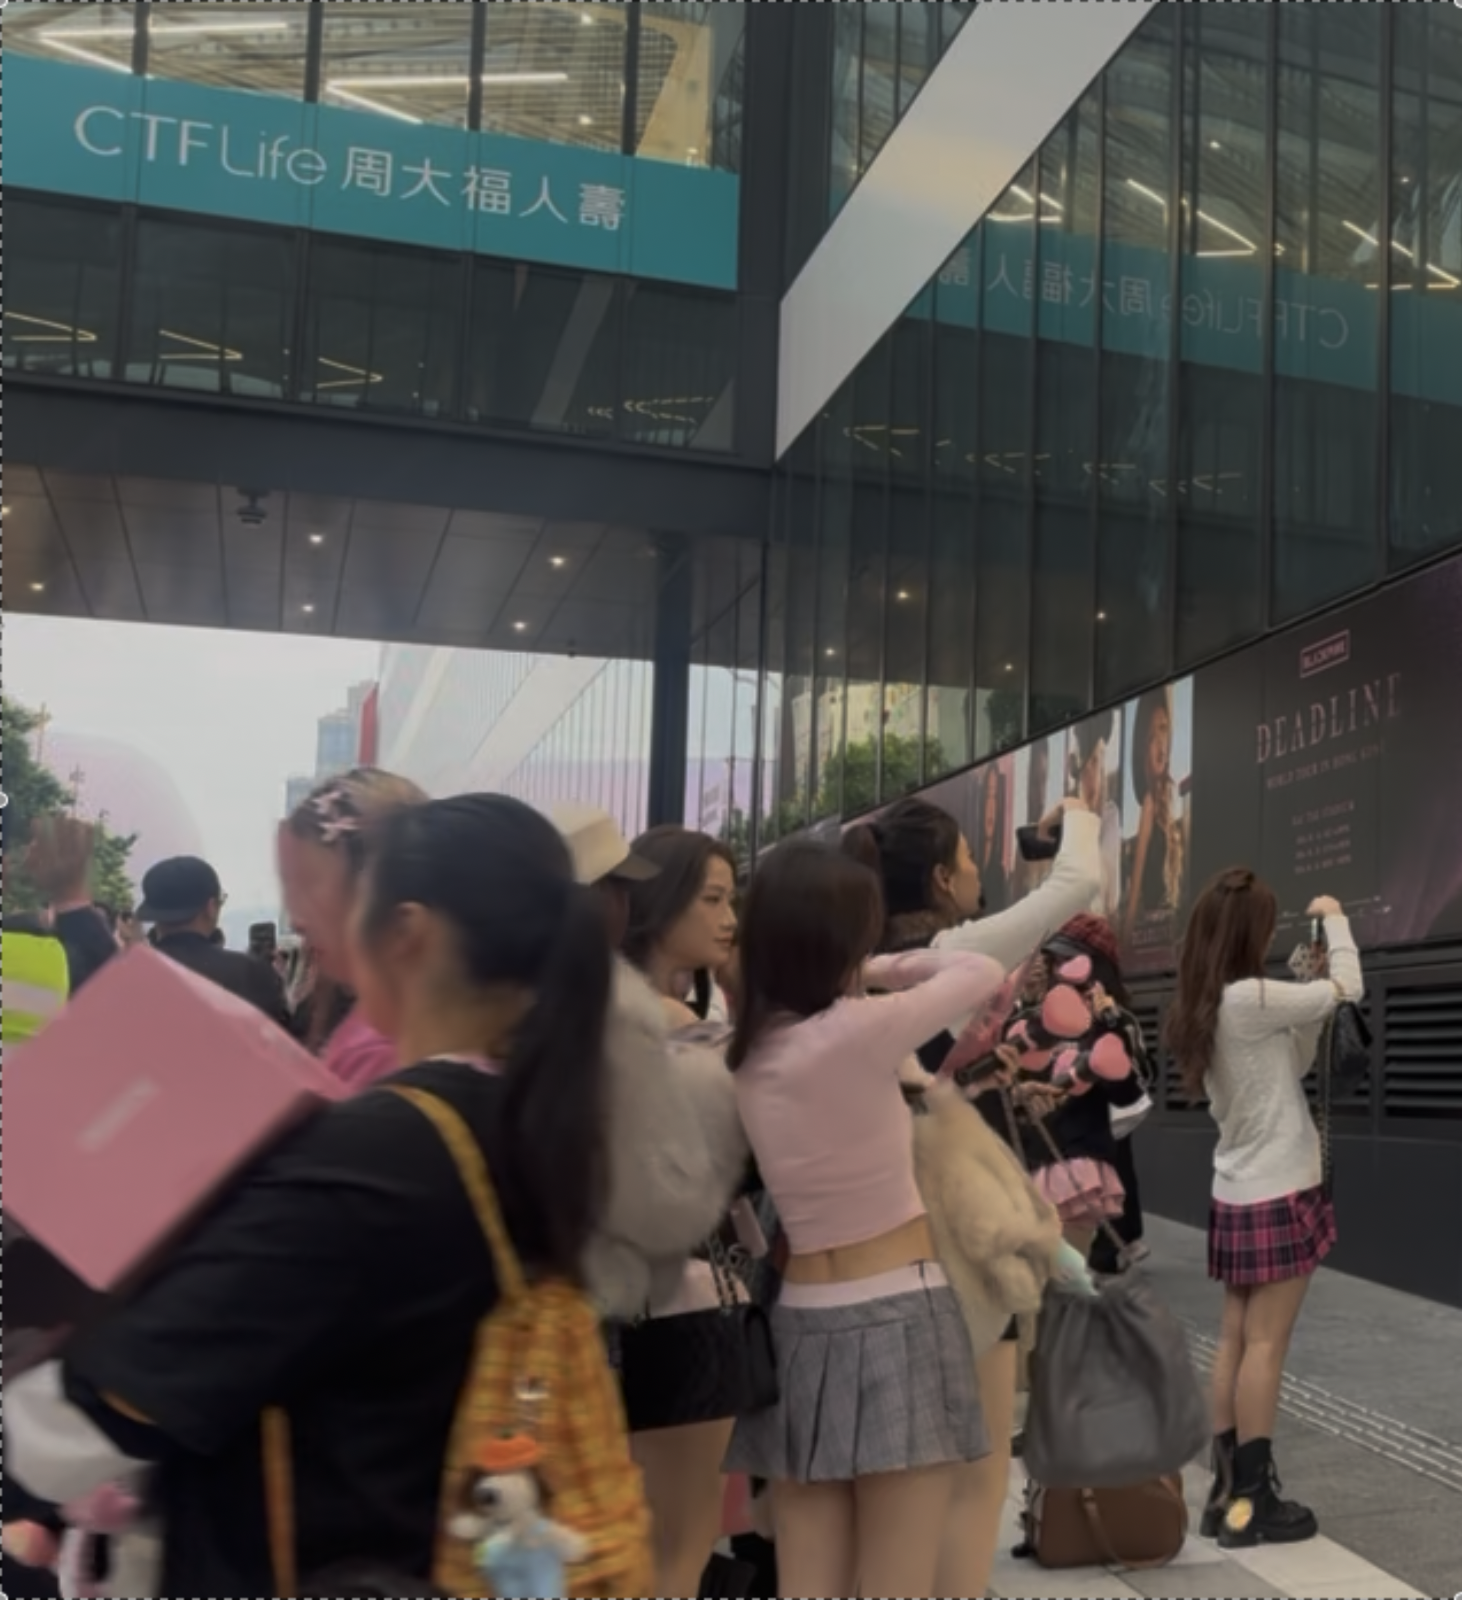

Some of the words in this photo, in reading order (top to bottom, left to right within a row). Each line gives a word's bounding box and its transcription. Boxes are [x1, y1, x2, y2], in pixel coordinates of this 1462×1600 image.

[340, 146, 626, 231] 周大福人壽
[1255, 671, 1401, 764] DEADLINE
